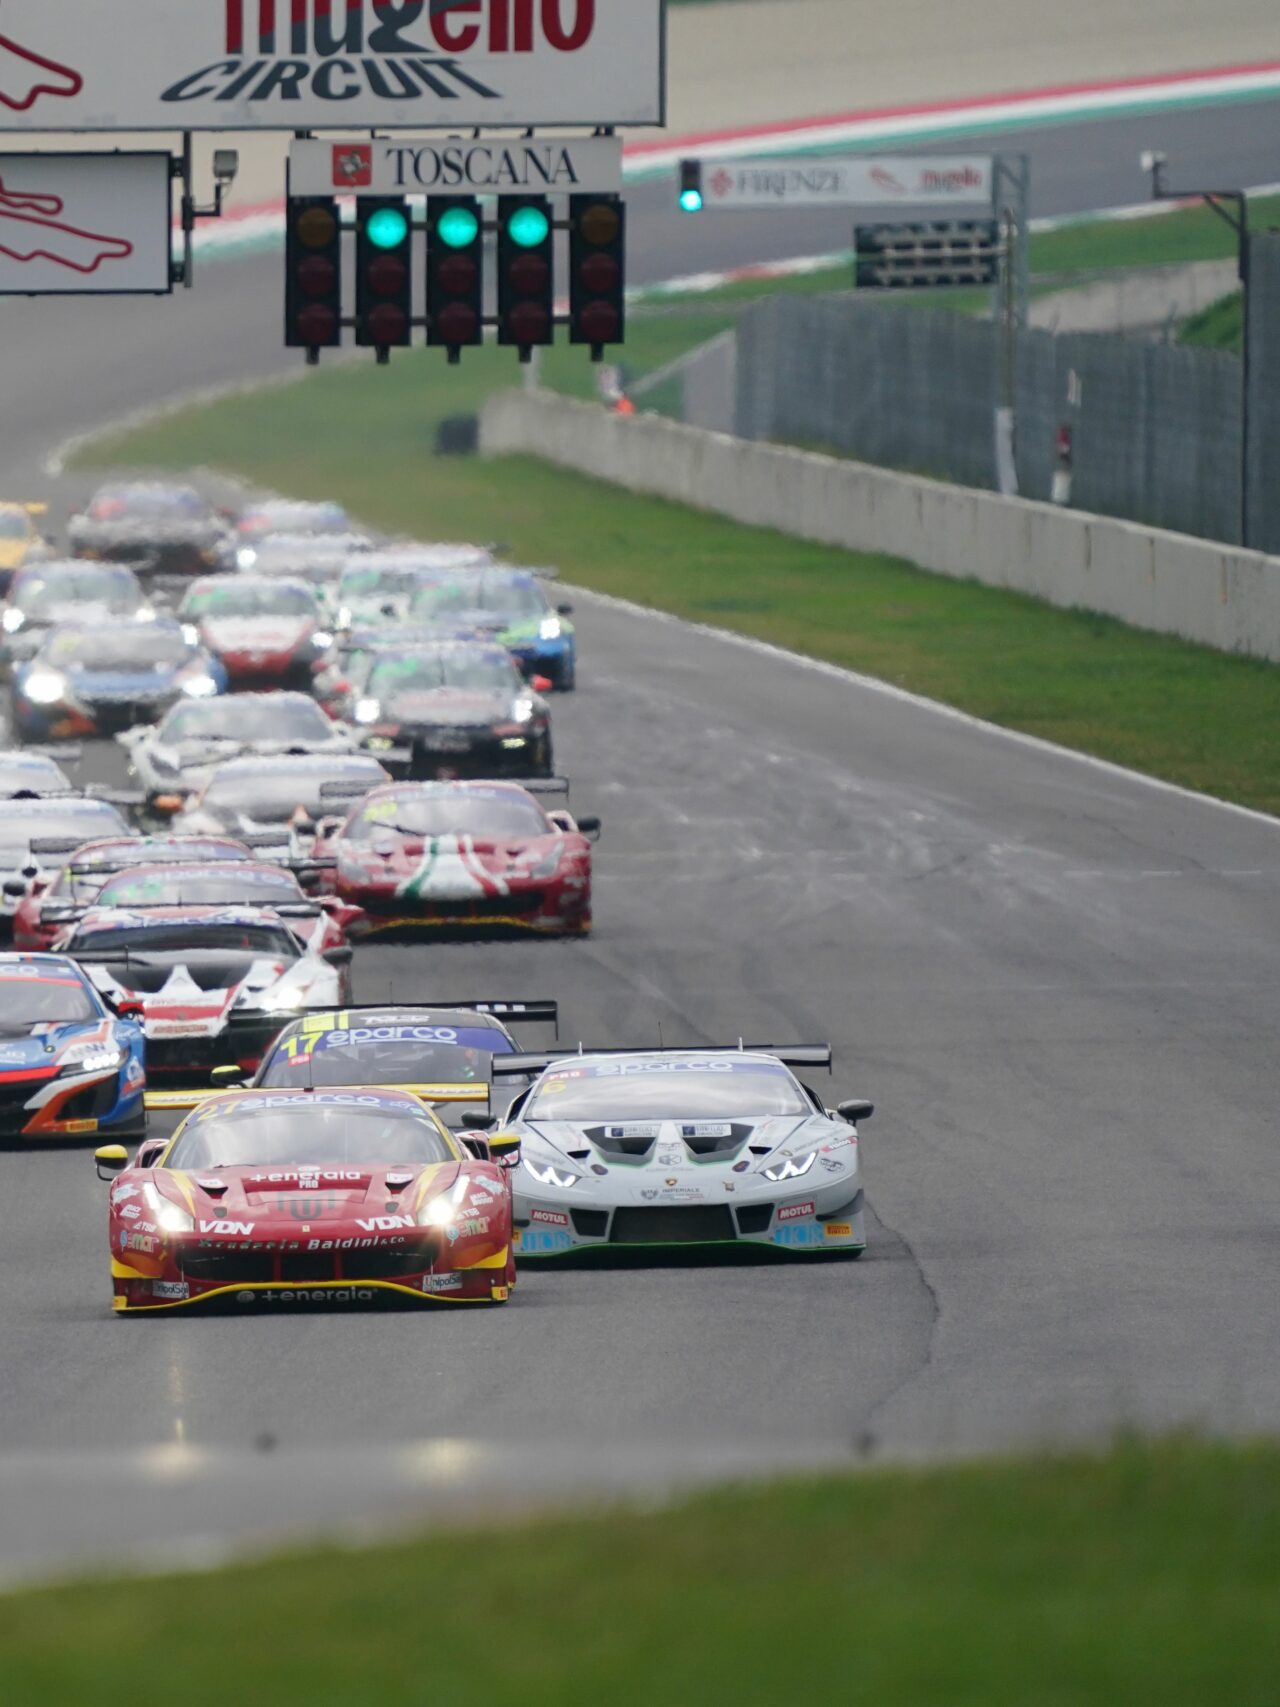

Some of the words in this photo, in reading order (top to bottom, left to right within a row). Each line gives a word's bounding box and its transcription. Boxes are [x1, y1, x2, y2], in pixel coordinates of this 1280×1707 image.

[160, 59, 503, 101] CIRCUIT
[387, 147, 579, 185] TOSCANA
[281, 1030, 323, 1058] 17
[326, 1026, 458, 1047] sparco
[594, 1062, 734, 1077] sparco
[542, 1080, 567, 1095] 6
[199, 1099, 242, 1121] 27
[242, 1092, 381, 1109] sparco
[299, 1179, 319, 1189] PRO
[533, 1211, 567, 1224] MOTUL
[780, 1204, 813, 1219] MOTUL
[199, 1219, 255, 1236] VDN
[355, 1214, 416, 1232] VDN
[307, 1236, 379, 1251] Baldini
